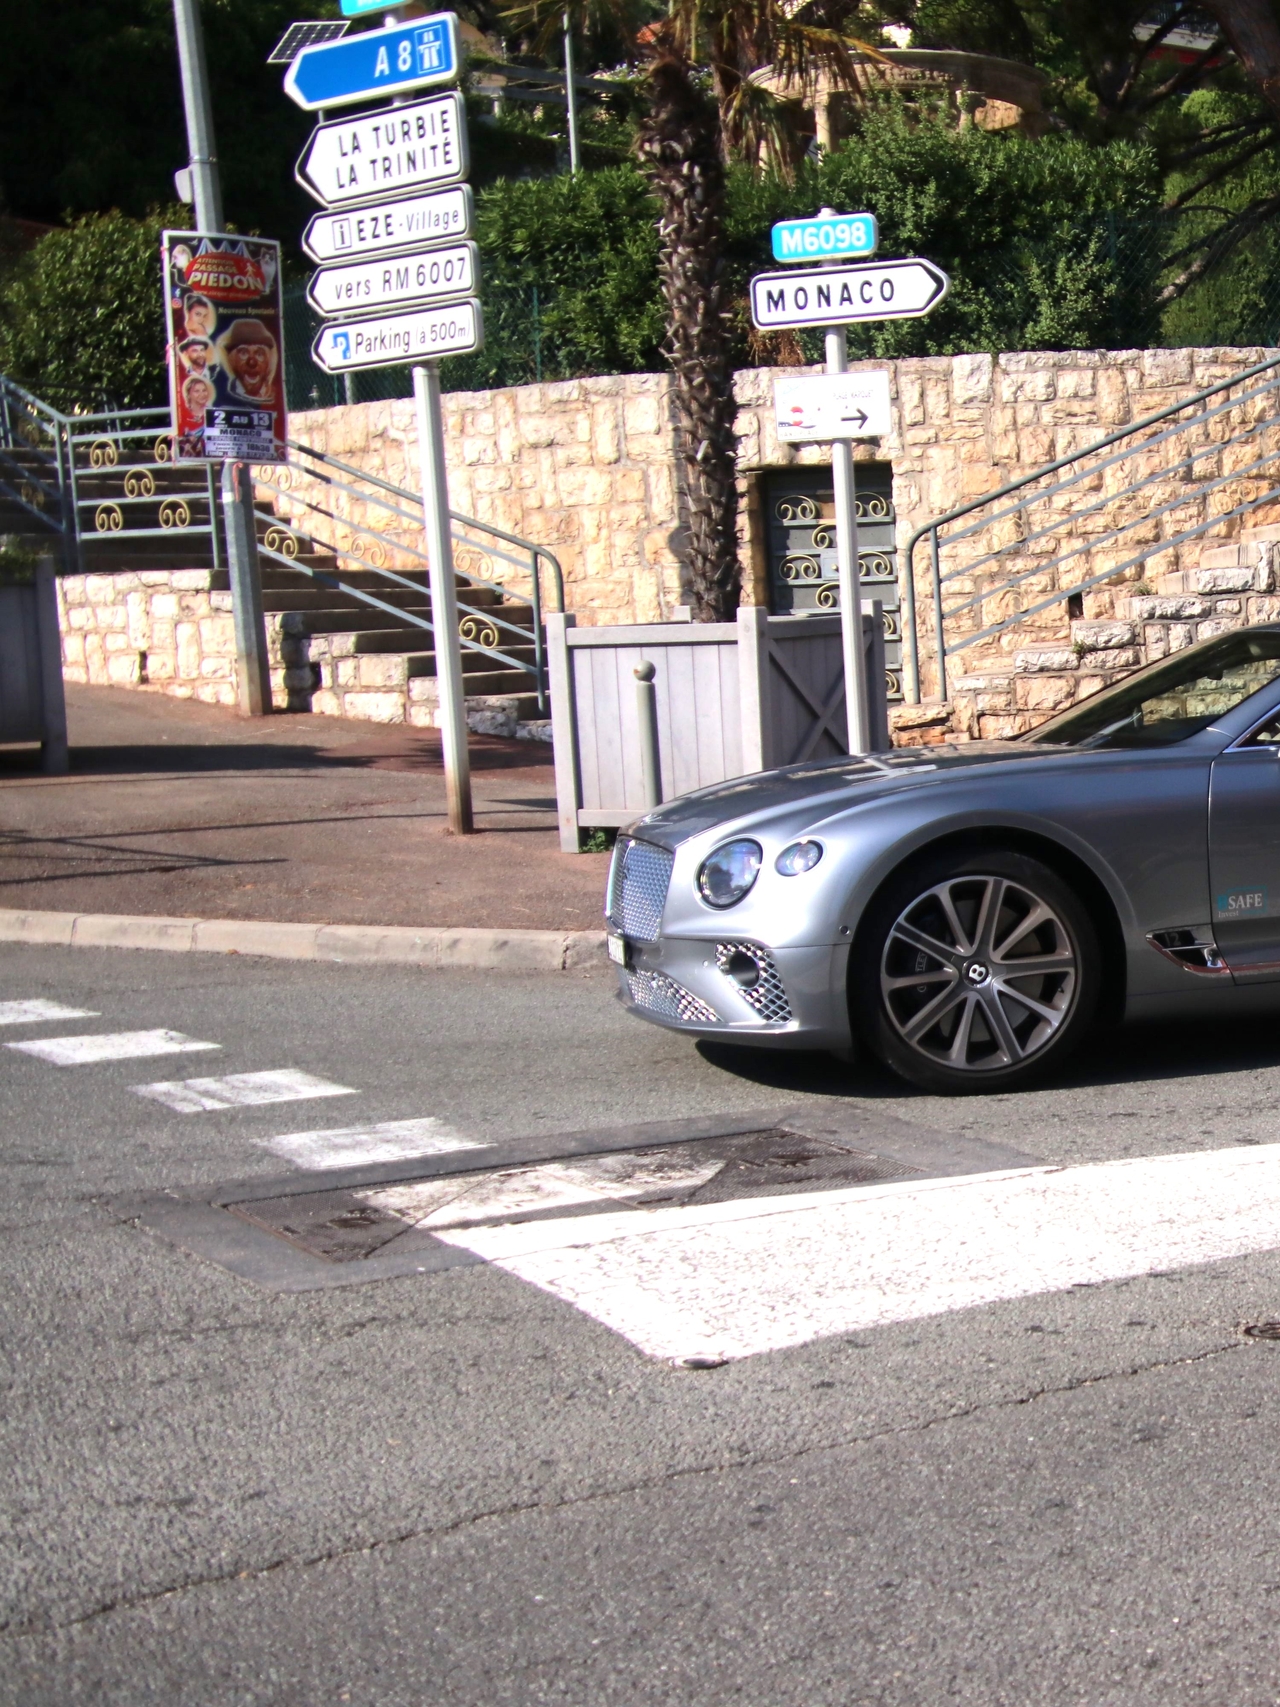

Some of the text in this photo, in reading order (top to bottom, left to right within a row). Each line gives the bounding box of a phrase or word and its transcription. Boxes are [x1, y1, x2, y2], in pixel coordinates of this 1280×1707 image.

[374, 40, 412, 78] A 8
[338, 109, 451, 157] LA TURBIE
[336, 136, 453, 189] LA TRINITÉ
[781, 221, 867, 254] M6098
[187, 271, 264, 290] PIEDON
[193, 263, 238, 273] PASSAGE
[335, 257, 466, 300] vers RM 6007
[766, 278, 895, 313] MONACO
[355, 327, 411, 354] Parking
[213, 410, 270, 426] 2 AU 13
[220, 428, 262, 437] MONACO
[1228, 893, 1263, 910] SAFE
